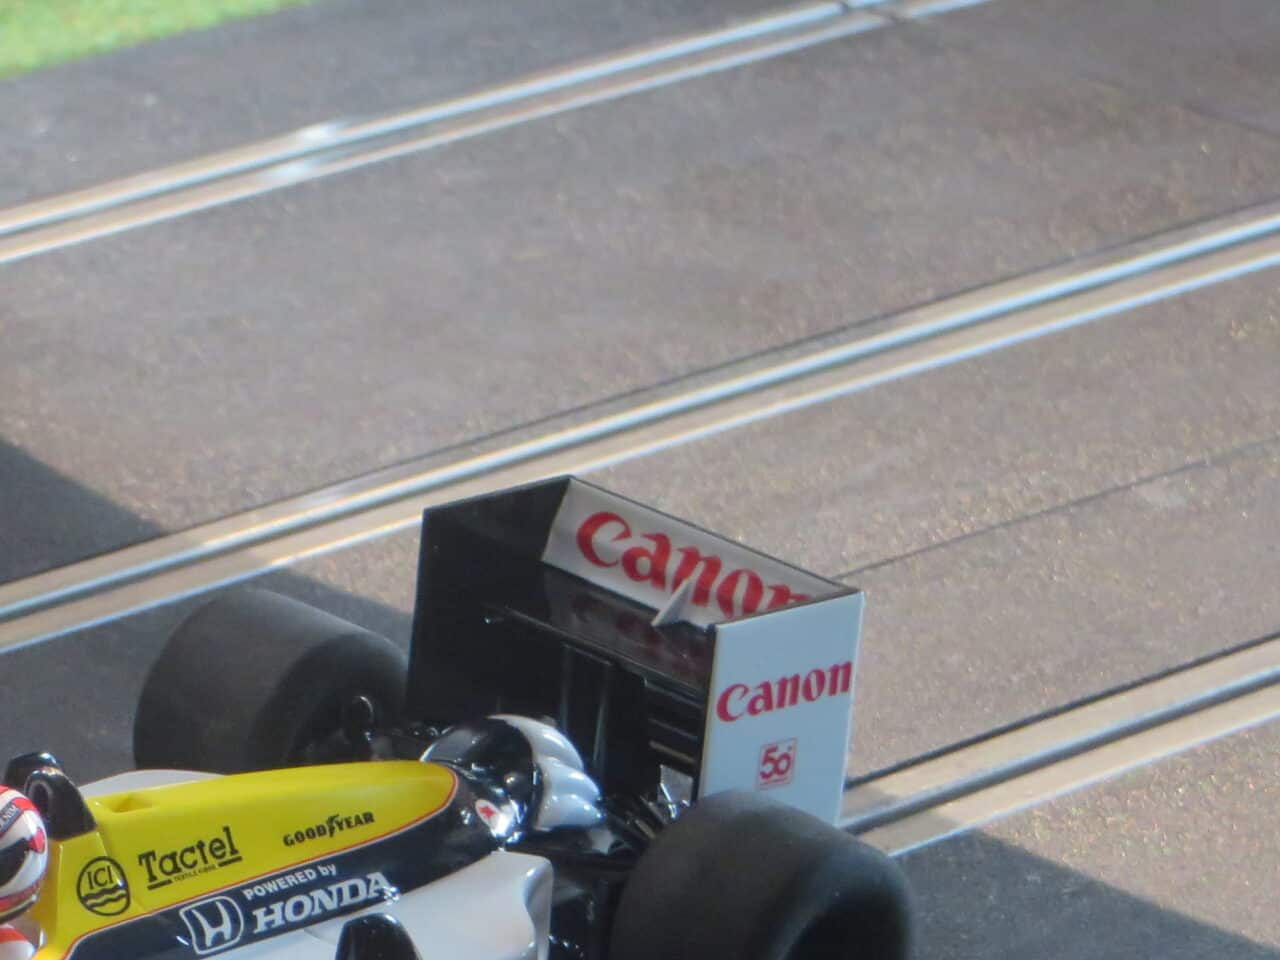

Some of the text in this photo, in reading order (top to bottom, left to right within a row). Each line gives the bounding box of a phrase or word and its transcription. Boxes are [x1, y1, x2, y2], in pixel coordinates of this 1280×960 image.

[716, 661, 853, 723] Canon
[282, 811, 376, 848] GOODYEAR
[86, 864, 114, 890] ICI
[137, 825, 240, 884] Tactel
[242, 867, 318, 901] POWERED
[319, 863, 338, 885] by
[252, 871, 393, 935] HONDA
